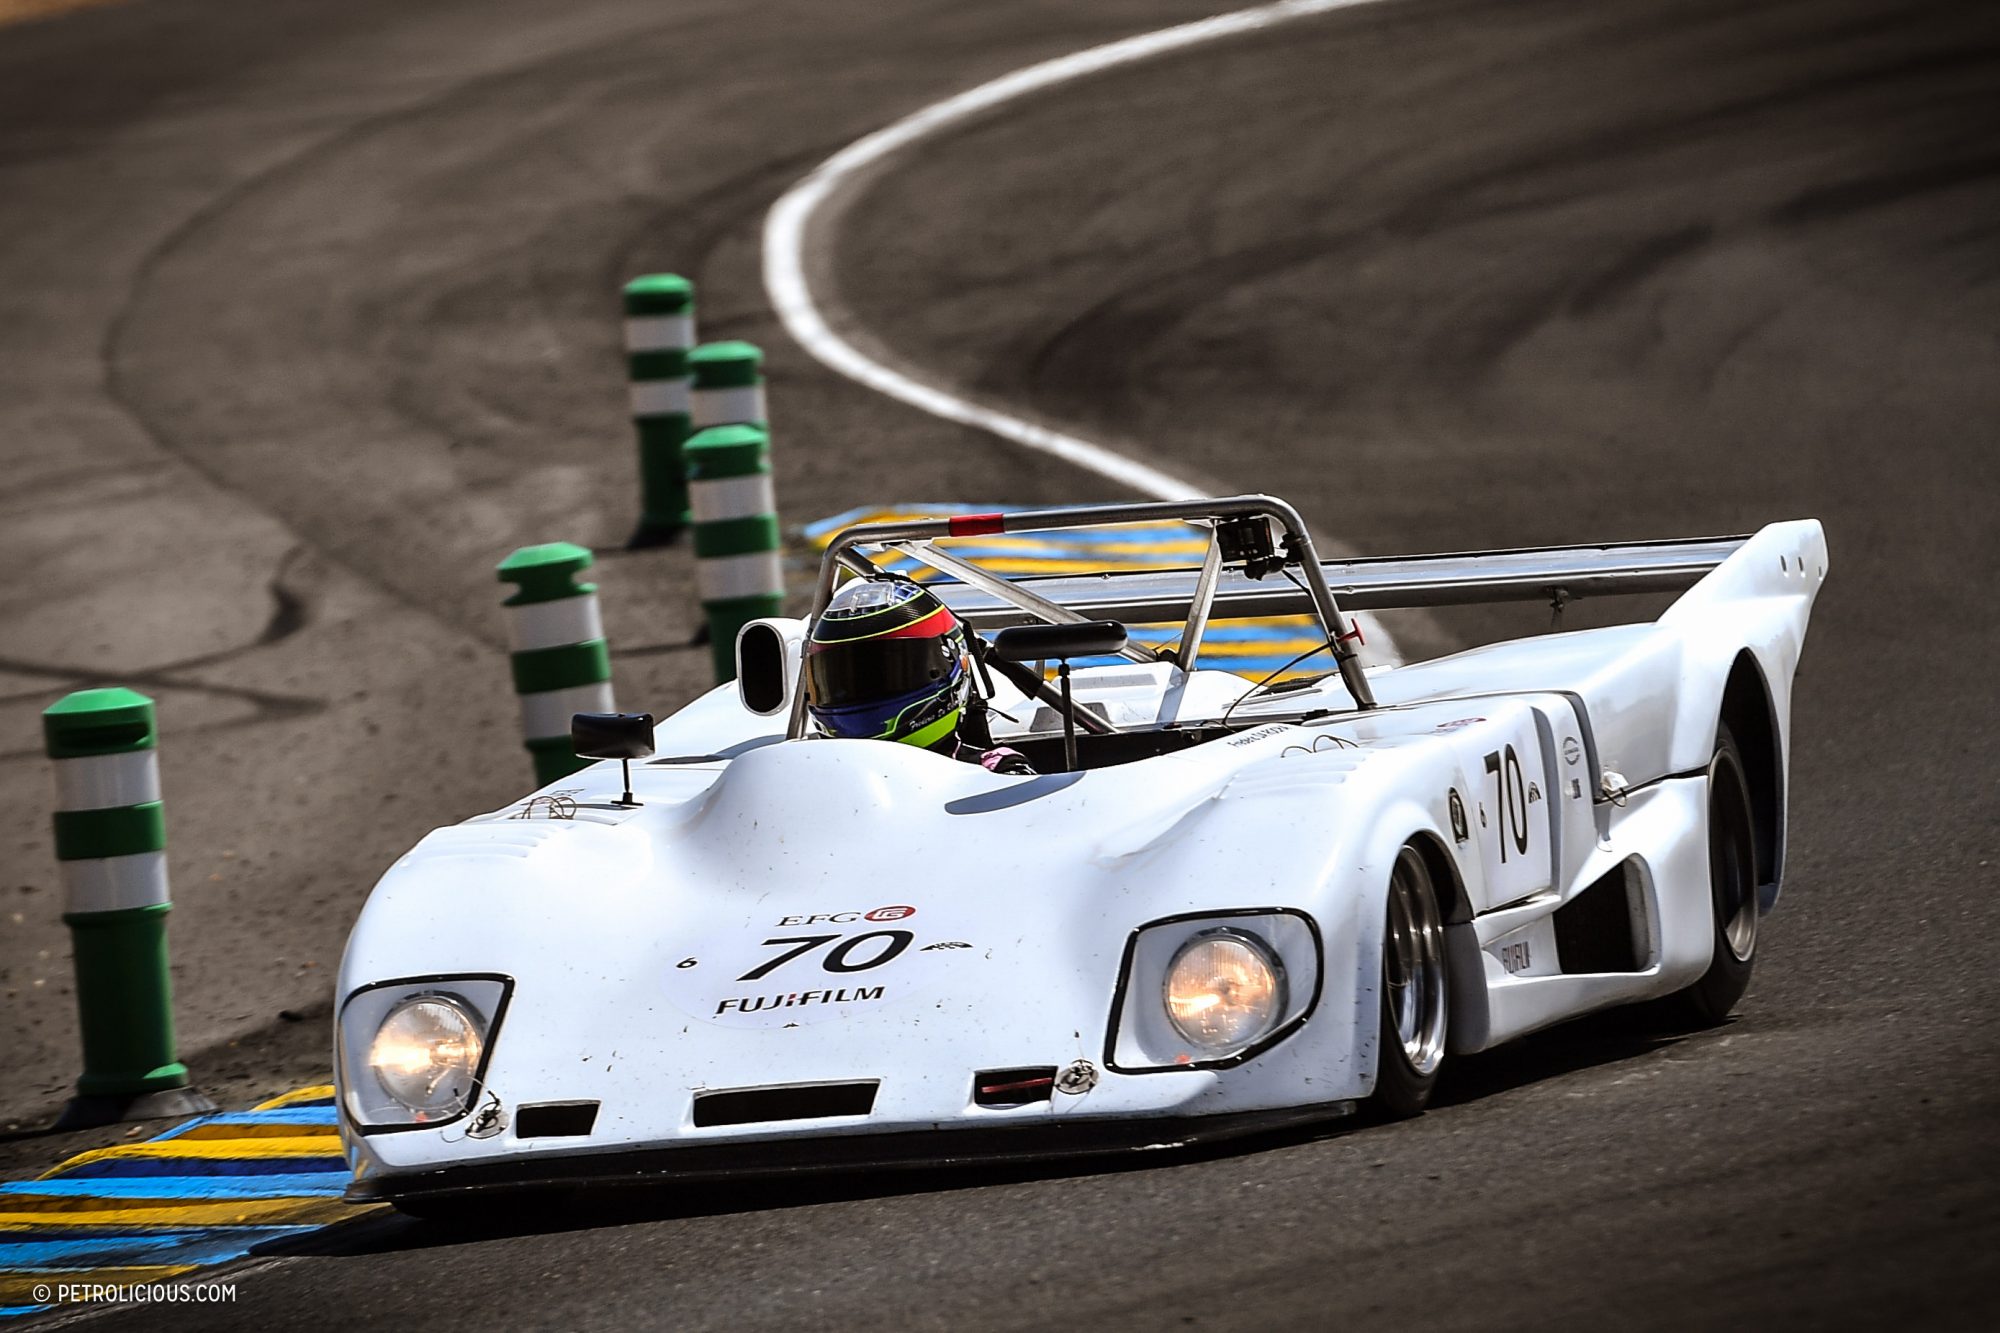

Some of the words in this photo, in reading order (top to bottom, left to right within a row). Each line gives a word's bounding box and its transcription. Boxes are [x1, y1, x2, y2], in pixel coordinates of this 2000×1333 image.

[1483, 743, 1528, 863] 70
[775, 912, 861, 926] EFG
[676, 957, 698, 969] 6
[736, 930, 914, 981] 70
[716, 987, 885, 1014] FUJIFILM
